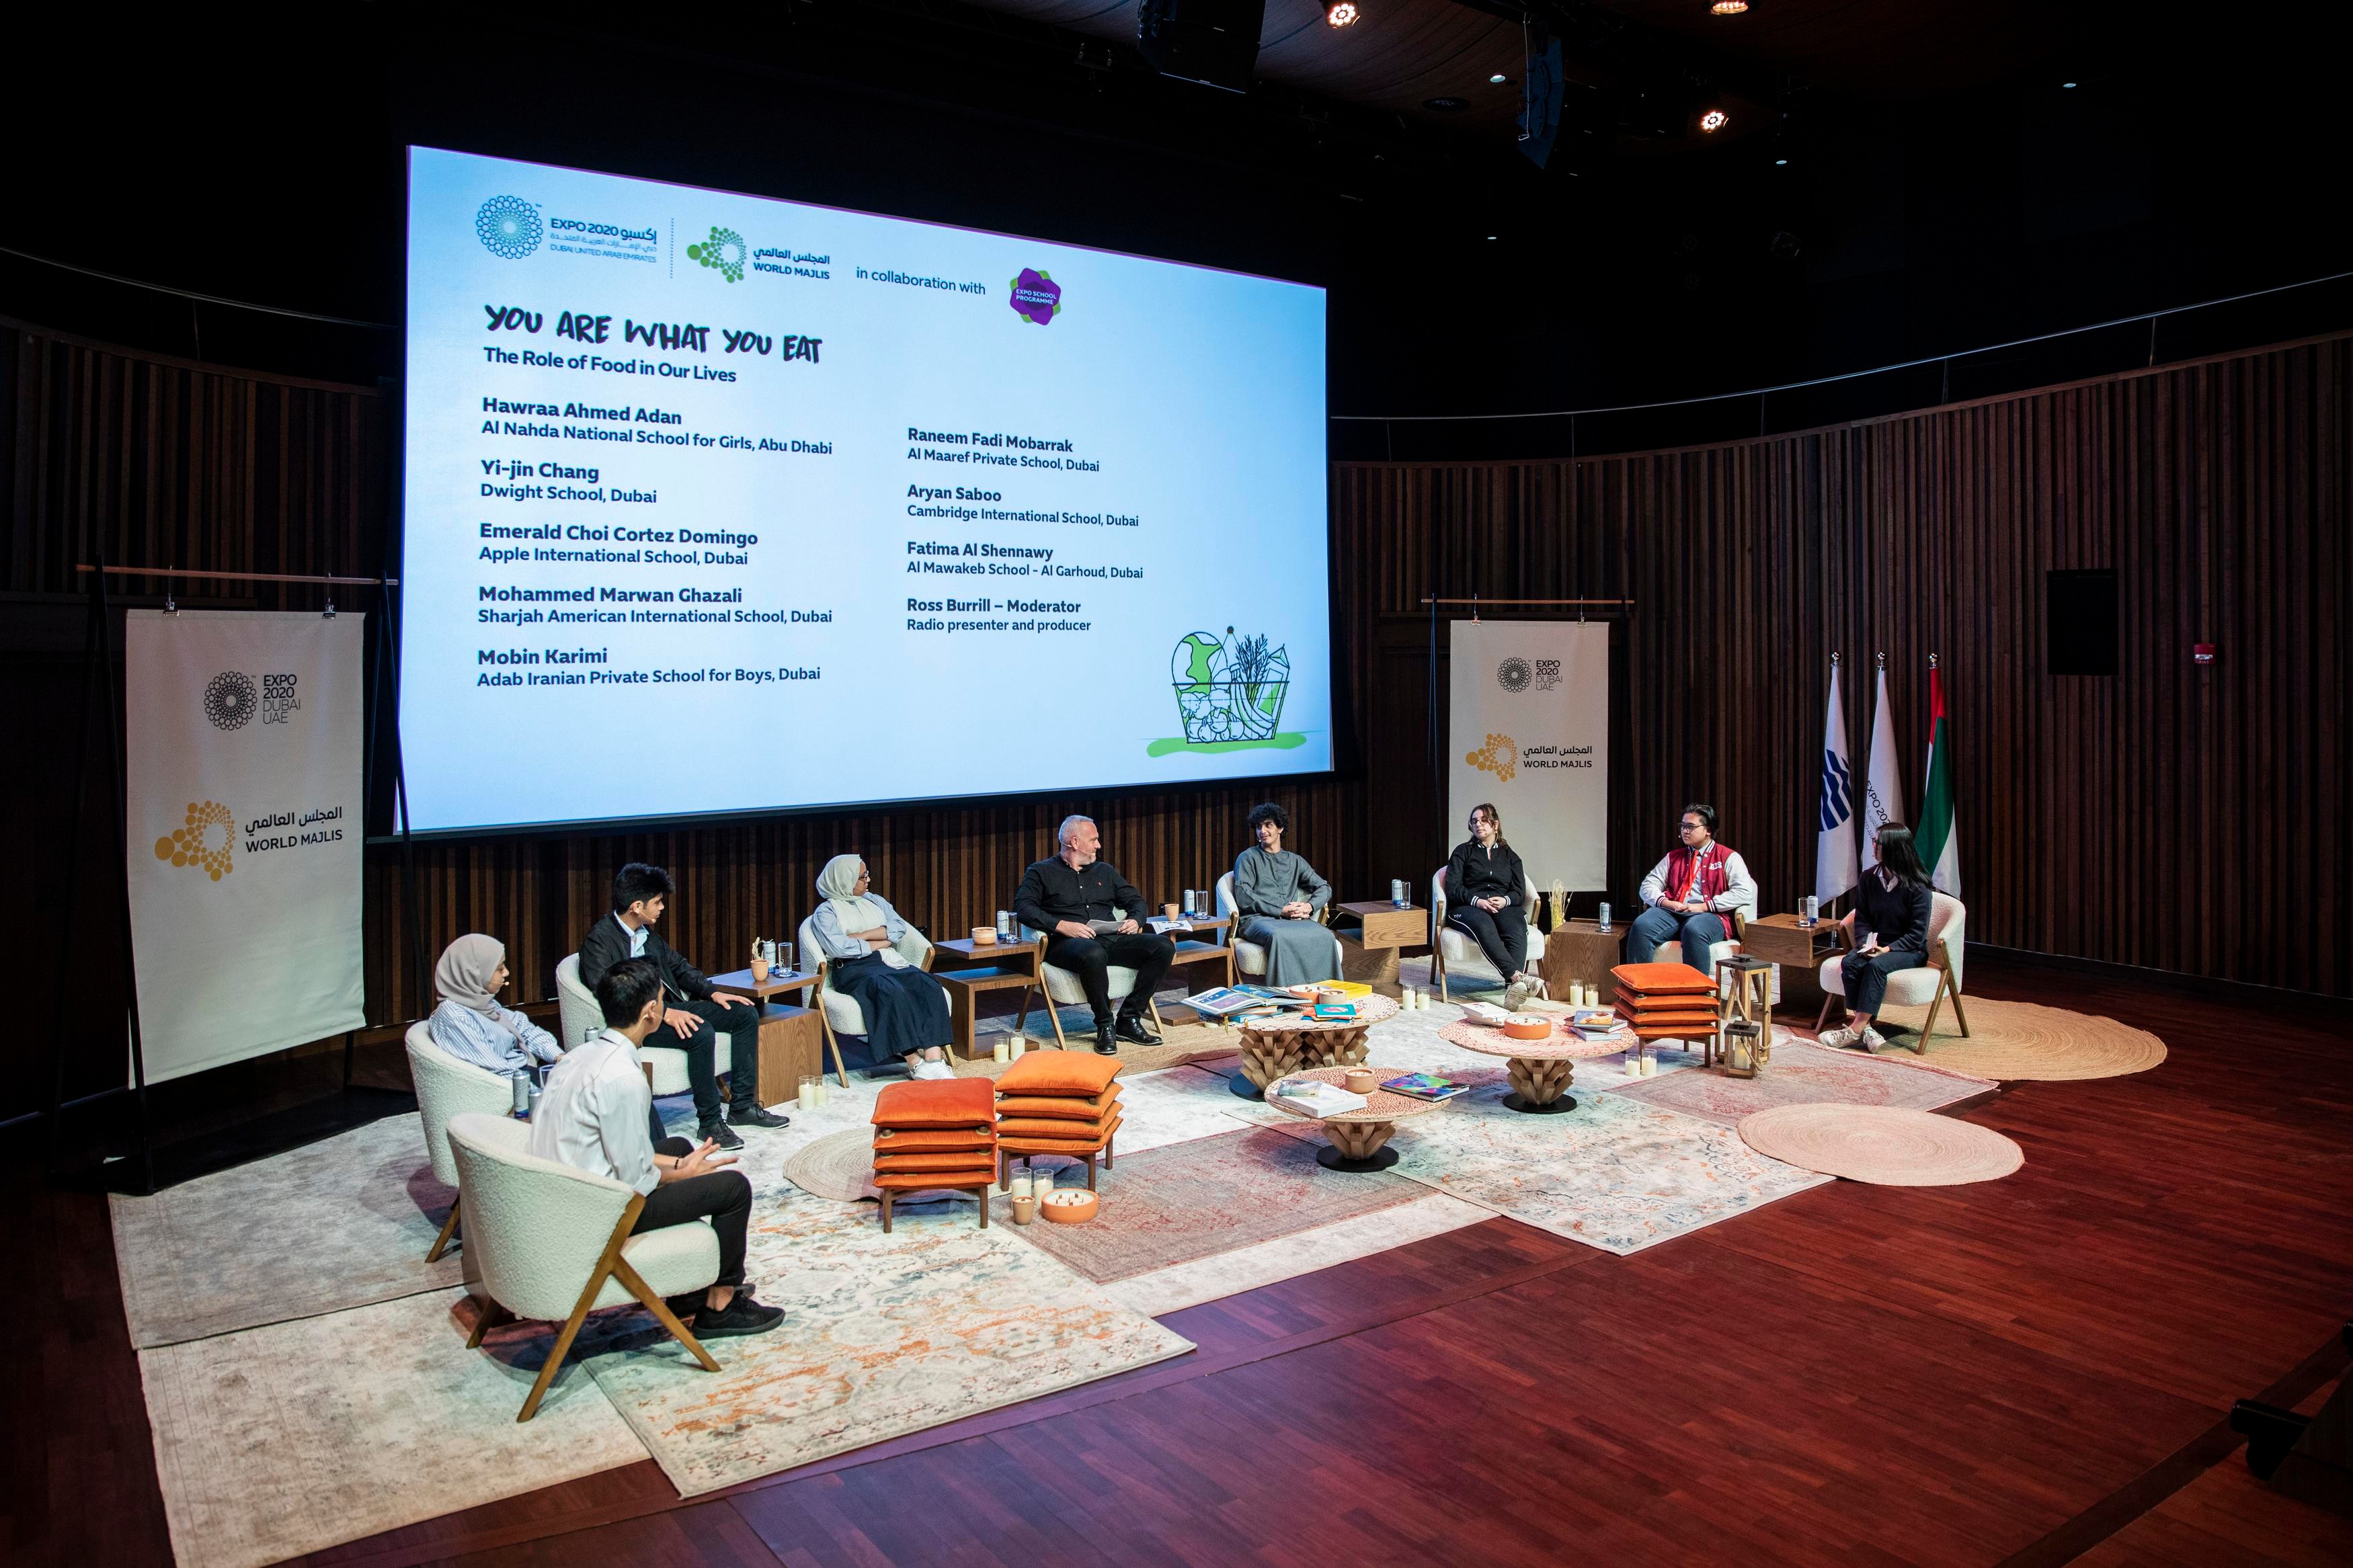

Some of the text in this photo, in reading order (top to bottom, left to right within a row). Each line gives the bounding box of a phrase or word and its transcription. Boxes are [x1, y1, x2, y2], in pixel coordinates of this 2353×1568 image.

[551, 218, 656, 245] EXPO 2020 إكسبو
[575, 247, 601, 256] UNITED
[754, 248, 830, 265] المجلس العالمي
[754, 262, 830, 280] WORLD MAJLIS
[856, 266, 986, 295] in collaboration with
[1016, 296, 1053, 304] PROGRAMME
[1033, 291, 1056, 299] SCHOOL
[484, 304, 822, 364] YOU ARE WHAT YOU EAT
[483, 347, 736, 382] The Role of Food in Our Lives
[483, 397, 681, 425] Hawraa Ahmed Adan
[481, 420, 832, 454] Al Nahda National School for Girls, Abu Dhabi
[908, 427, 1073, 452] Raneem Fadi Mobarrak
[908, 448, 1099, 471] Al Maaref Private School, Dubai
[481, 459, 599, 483] Yi-jin Chang
[481, 483, 657, 503] Dwight School, Dubai
[908, 484, 1001, 501] Aryan Saboo
[908, 505, 1138, 526] Cambridge International School, Dubai
[480, 522, 758, 548] Emerald Choi Cortez Domingo
[479, 546, 748, 565] Apple International School, Dubai
[908, 541, 1053, 562] Fatima Al Shennawy
[907, 561, 920, 573] Al
[924, 562, 985, 574] Mawakeb
[989, 563, 1029, 575] School
[1041, 565, 1052, 575] Al
[1056, 565, 1107, 579] Garhoud,
[1111, 567, 1143, 578] Dubai
[479, 585, 742, 602] Mohammed Marwan Ghazali
[908, 598, 943, 611] Ross
[947, 598, 990, 612] Burrill
[1008, 600, 1080, 612] Moderator
[479, 608, 832, 626] Sharjah American International School, Dubai
[908, 618, 1091, 633] Radio presenter and producer
[477, 647, 607, 665] Mobin Karimi
[264, 674, 297, 686] EXPO
[477, 667, 820, 686] Adab Iranian Private School for Boys, Dubai
[264, 687, 294, 699] 2020
[264, 699, 301, 712] DUBAI
[264, 712, 288, 724] UAE
[1523, 746, 1592, 758] المجلس العالمي
[245, 807, 342, 836] المجلس العالمي
[245, 830, 343, 853] WORLD MAJLIS
